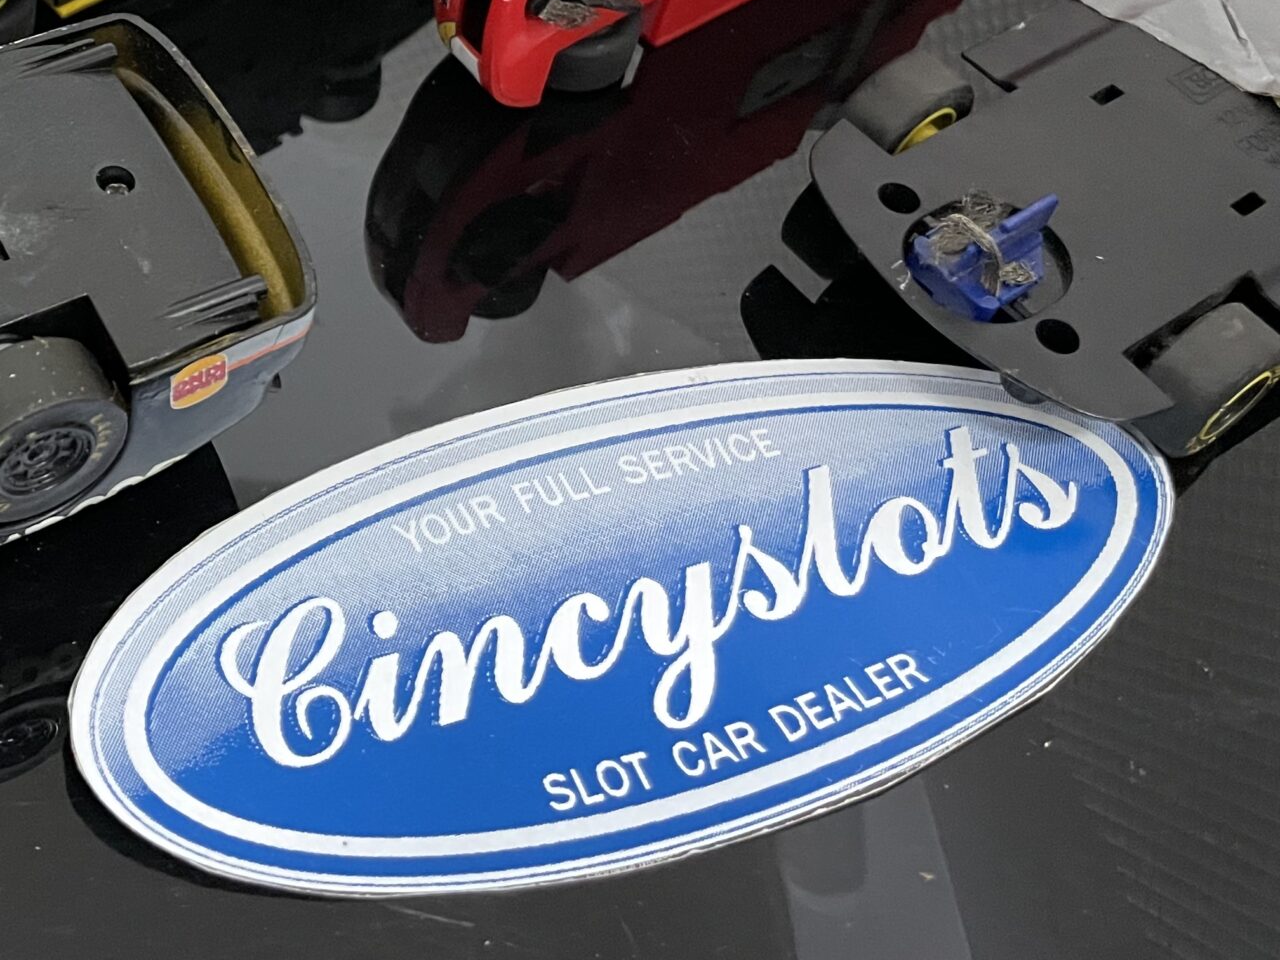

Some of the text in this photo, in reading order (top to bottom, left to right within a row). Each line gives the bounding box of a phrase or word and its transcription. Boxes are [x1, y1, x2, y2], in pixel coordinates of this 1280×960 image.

[391, 429, 781, 553] YOUR FULL SERVICE
[220, 425, 1081, 769] Cincyslots
[542, 652, 931, 811] SLOT CAR DEALER
